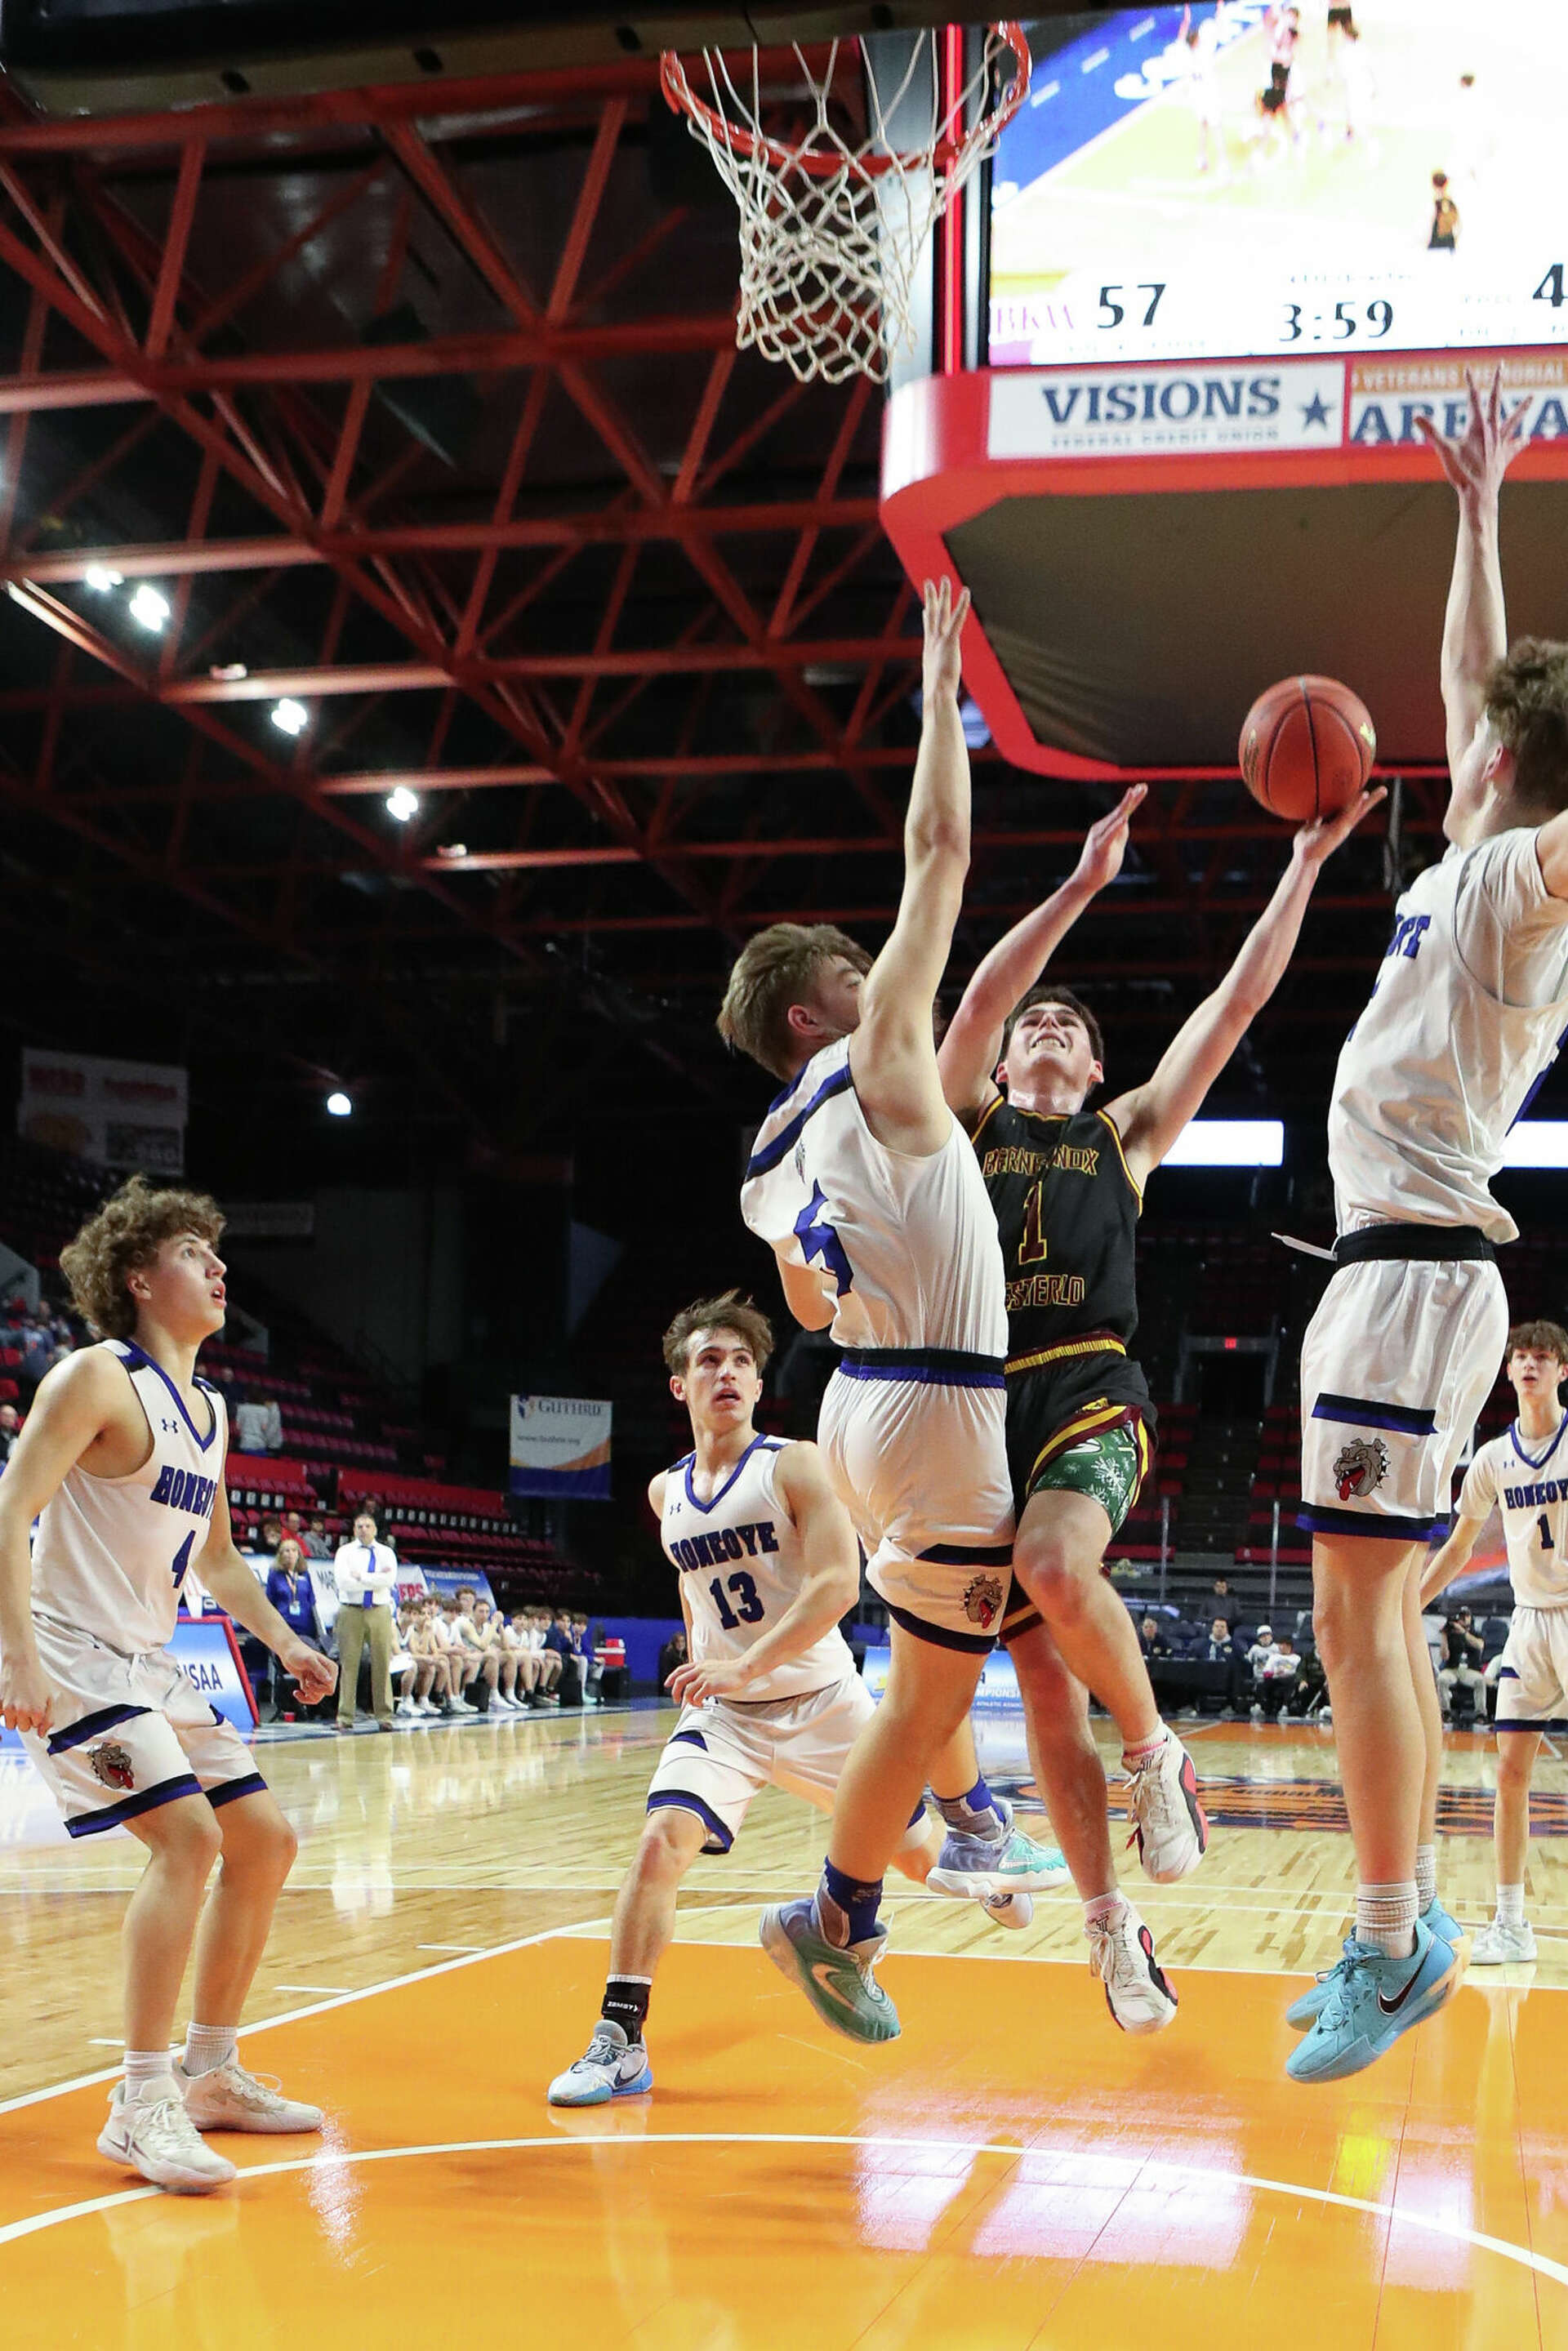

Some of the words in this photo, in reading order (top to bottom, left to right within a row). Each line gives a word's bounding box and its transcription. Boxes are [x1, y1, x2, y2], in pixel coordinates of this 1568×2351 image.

[1097, 283, 1166, 328] 57
[1279, 300, 1393, 341] 3:59
[1364, 366, 1459, 389] VETERANS
[1042, 378, 1281, 424] VISIONS
[1143, 430, 1208, 445] CREDIT
[1217, 426, 1279, 442] UNION
[1018, 1181, 1048, 1265] 1
[670, 1521, 780, 1573] HONEOYE
[1537, 1513, 1555, 1549] 1
[172, 1529, 196, 1589] 4
[709, 1570, 765, 1630] 13
